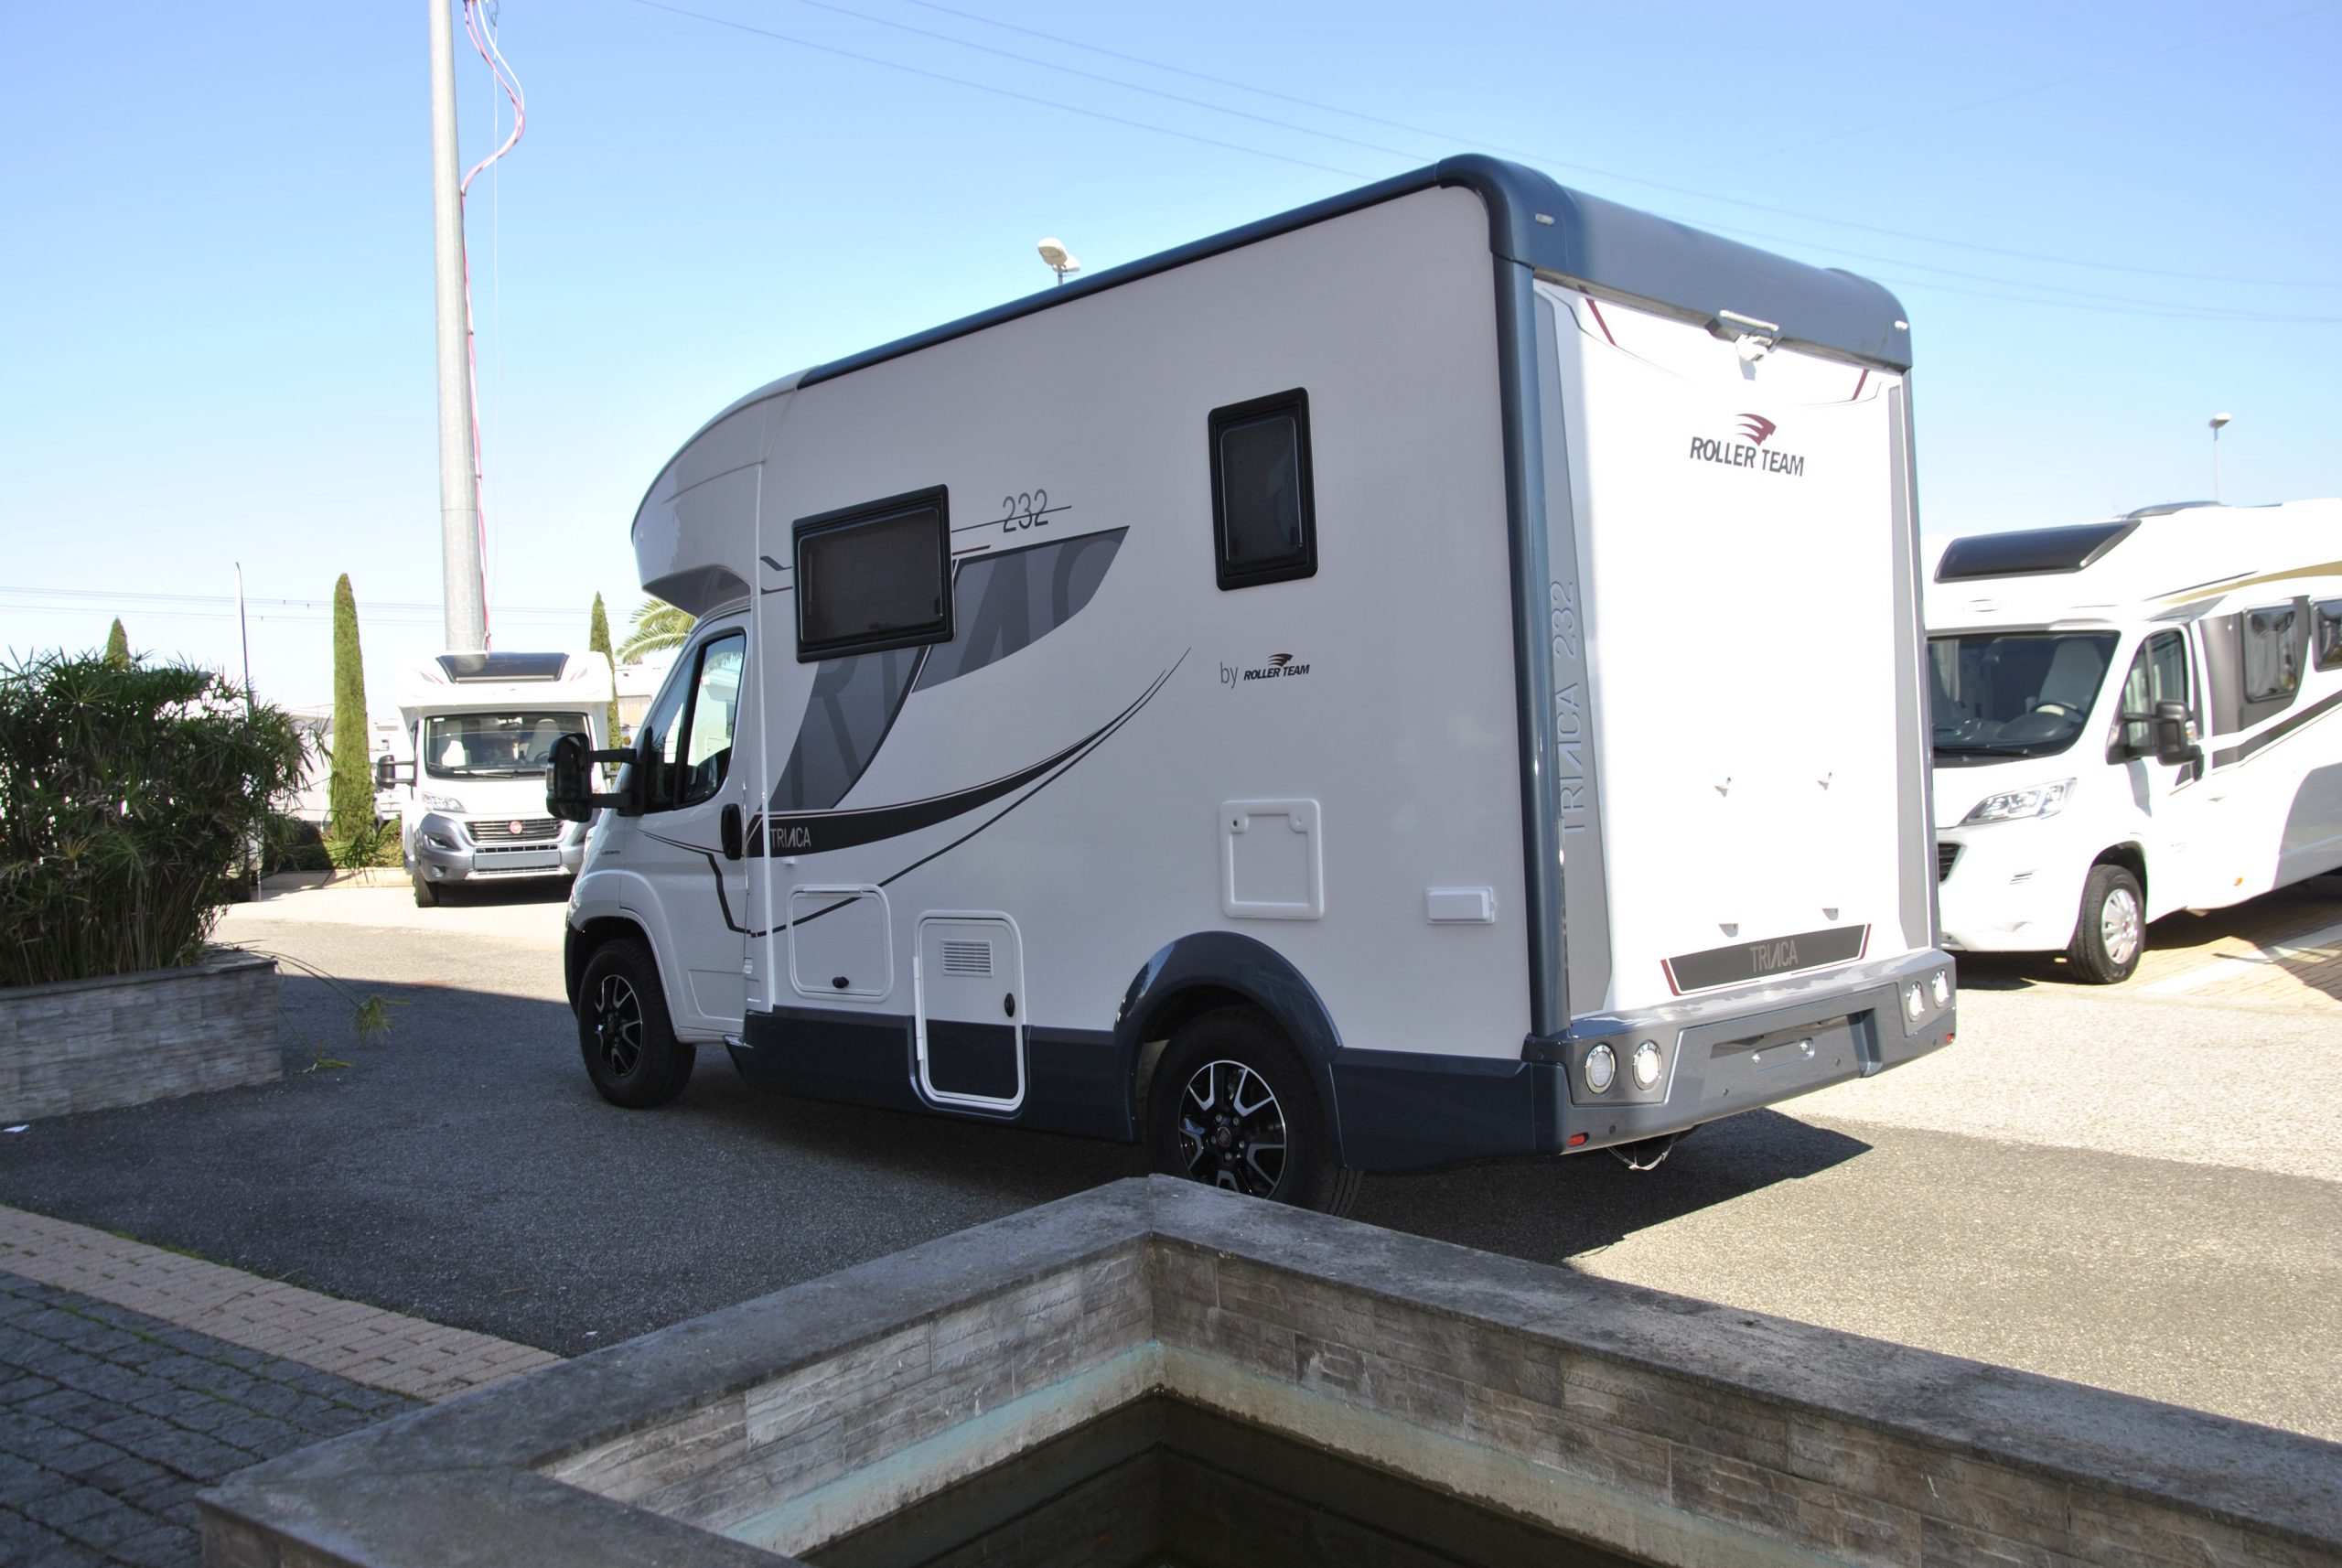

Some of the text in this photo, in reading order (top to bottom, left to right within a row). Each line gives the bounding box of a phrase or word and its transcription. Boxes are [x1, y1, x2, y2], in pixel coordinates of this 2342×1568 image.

[1690, 436, 1804, 477] ROLLER TEAM
[1003, 489, 1048, 533] 232
[1550, 579, 1577, 660] 232
[1220, 660, 1310, 690] by ROLLER TEAM
